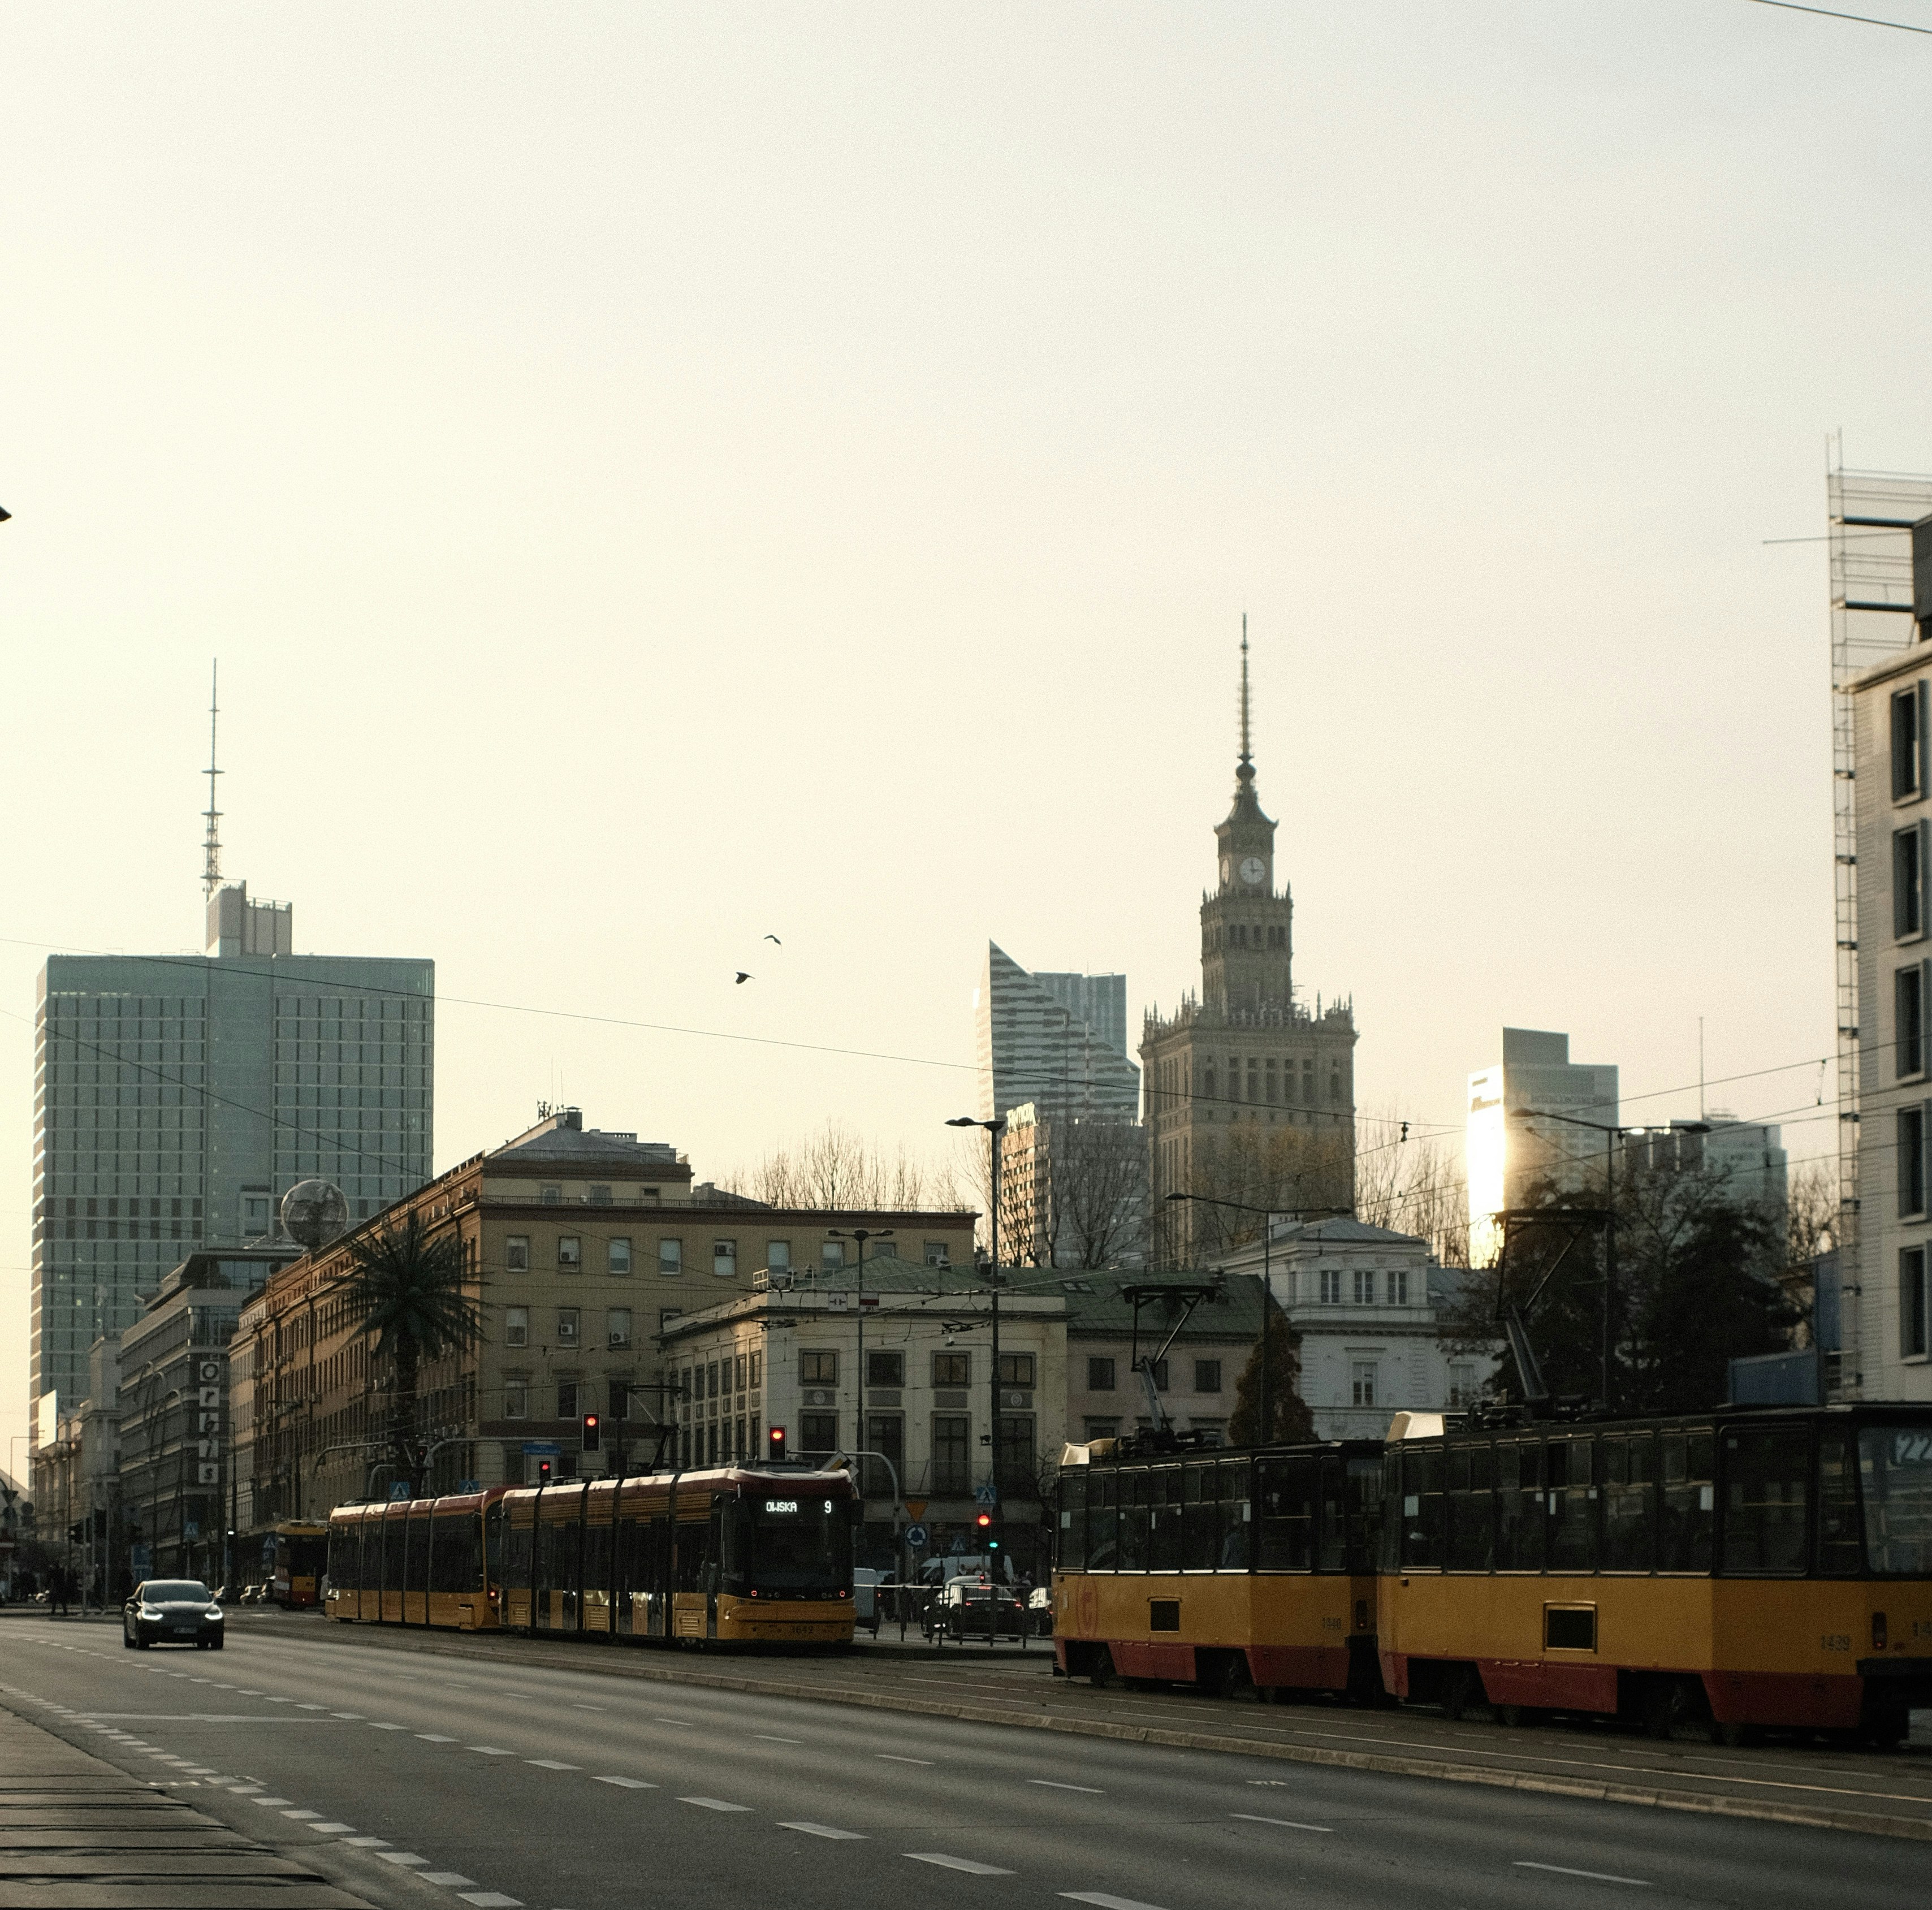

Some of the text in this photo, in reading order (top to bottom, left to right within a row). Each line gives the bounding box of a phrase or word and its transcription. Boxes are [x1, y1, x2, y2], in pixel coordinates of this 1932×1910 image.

[202, 1363, 219, 1480] Orbis
[766, 1500, 832, 1514] OWSKA 9
